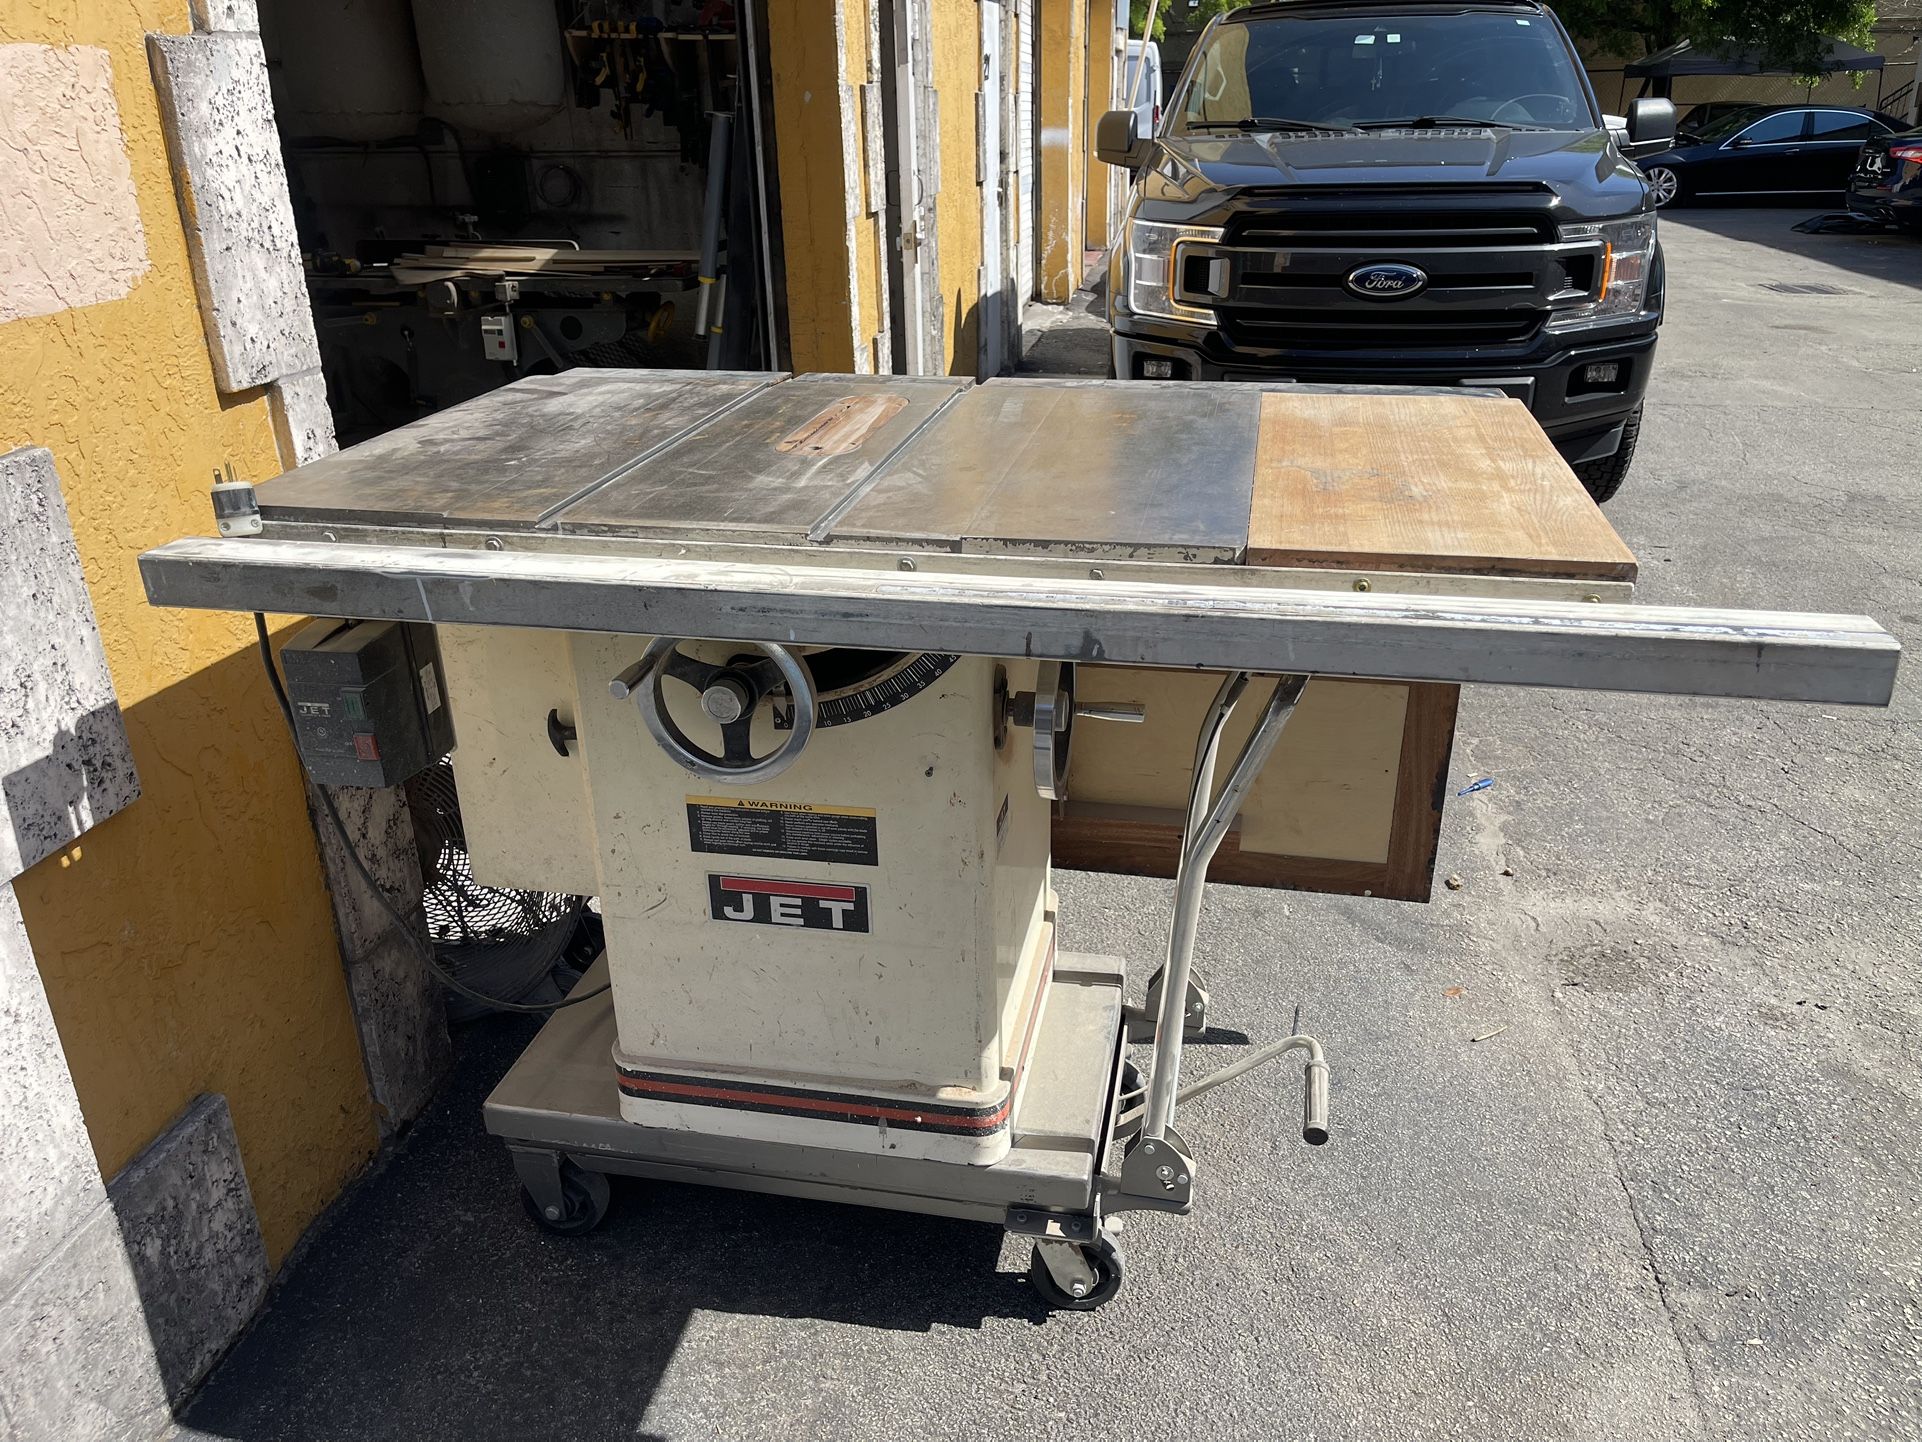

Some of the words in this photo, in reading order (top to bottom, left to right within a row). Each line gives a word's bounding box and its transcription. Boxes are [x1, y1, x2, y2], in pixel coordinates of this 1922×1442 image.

[1365, 271, 1406, 289] Ford
[901, 692, 909, 700] 30
[917, 680, 926, 689] 35
[949, 655, 957, 663] 45
[299, 706, 331, 715] JET
[747, 800, 813, 811] WARNING
[723, 893, 855, 929] JET
